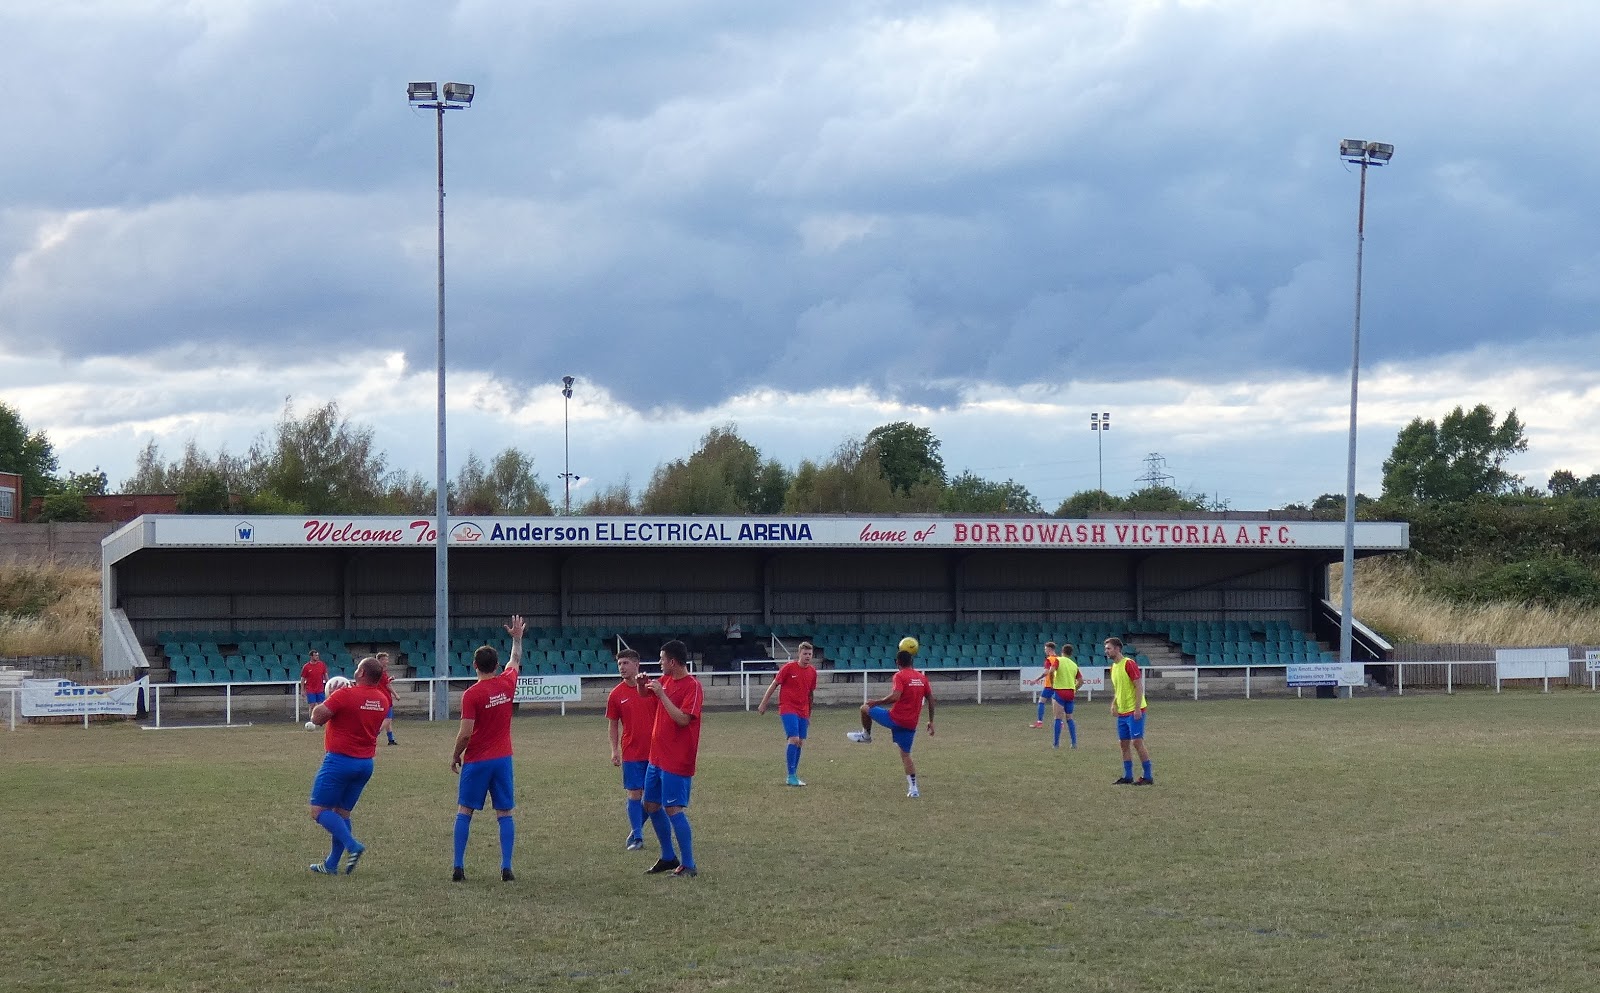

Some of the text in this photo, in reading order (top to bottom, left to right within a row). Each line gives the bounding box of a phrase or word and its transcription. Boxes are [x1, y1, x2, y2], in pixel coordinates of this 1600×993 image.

[238, 528, 252, 540] W
[303, 520, 437, 543] Welcome To
[490, 522, 813, 541] Anderson ELECTRICAL ARENA
[859, 523, 937, 543] home of
[953, 523, 1296, 545] BORROWASH VICTORIA A.F.C.
[515, 684, 577, 696] STRUCTION
[516, 677, 544, 685] TREET
